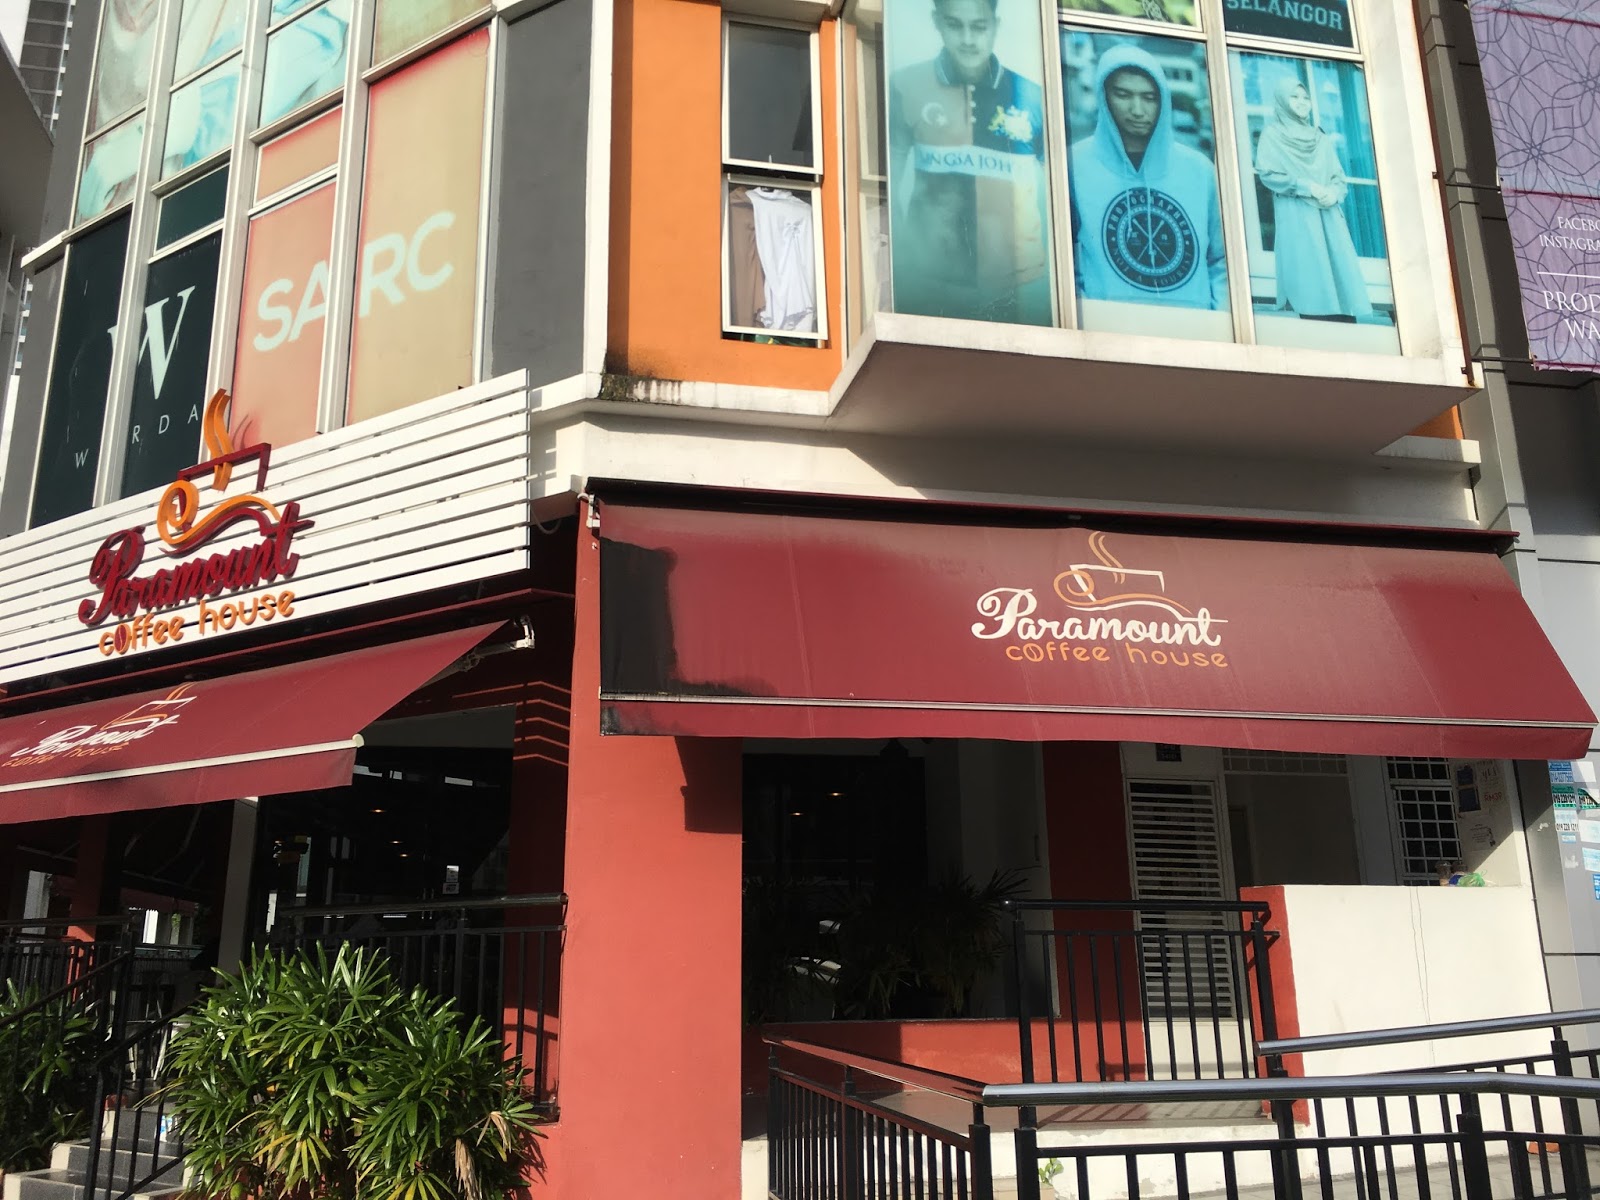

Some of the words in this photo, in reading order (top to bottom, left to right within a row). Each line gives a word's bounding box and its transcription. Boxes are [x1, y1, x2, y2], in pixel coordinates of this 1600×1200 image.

[1227, 0, 1343, 31] SELANGOR
[75, 404, 199, 470] WRDA
[78, 501, 316, 627] Paramount
[99, 613, 185, 657] coffee
[199, 590, 296, 636] house
[970, 587, 1229, 647] Paramount
[1005, 641, 1110, 662] coffee
[1125, 642, 1229, 667] house
